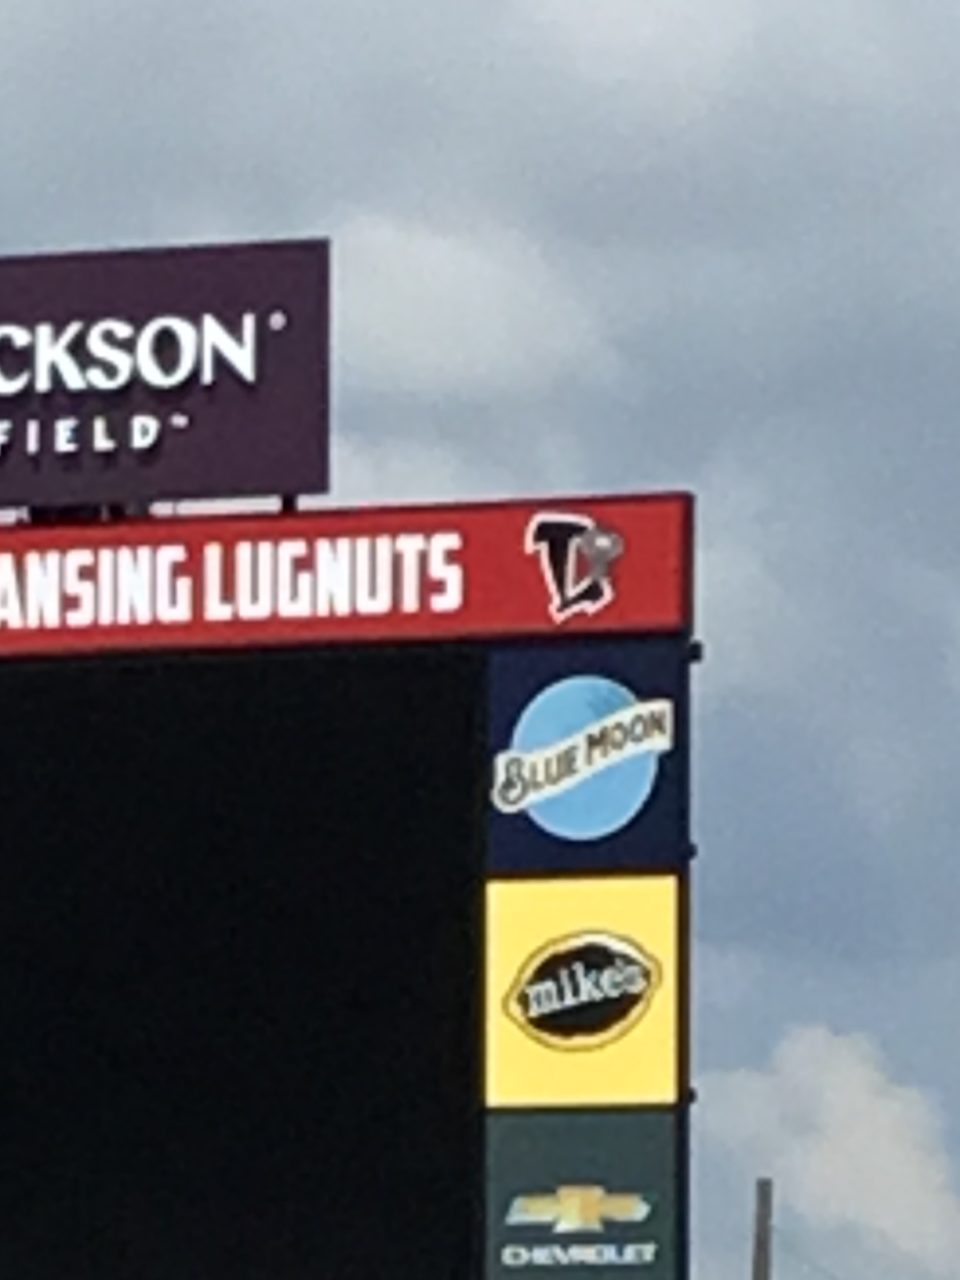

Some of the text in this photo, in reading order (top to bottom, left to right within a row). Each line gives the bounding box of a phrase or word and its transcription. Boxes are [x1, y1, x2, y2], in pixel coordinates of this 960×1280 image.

[202, 532, 464, 622] LUGNUTS
[499, 710, 668, 806] BLUE MOON
